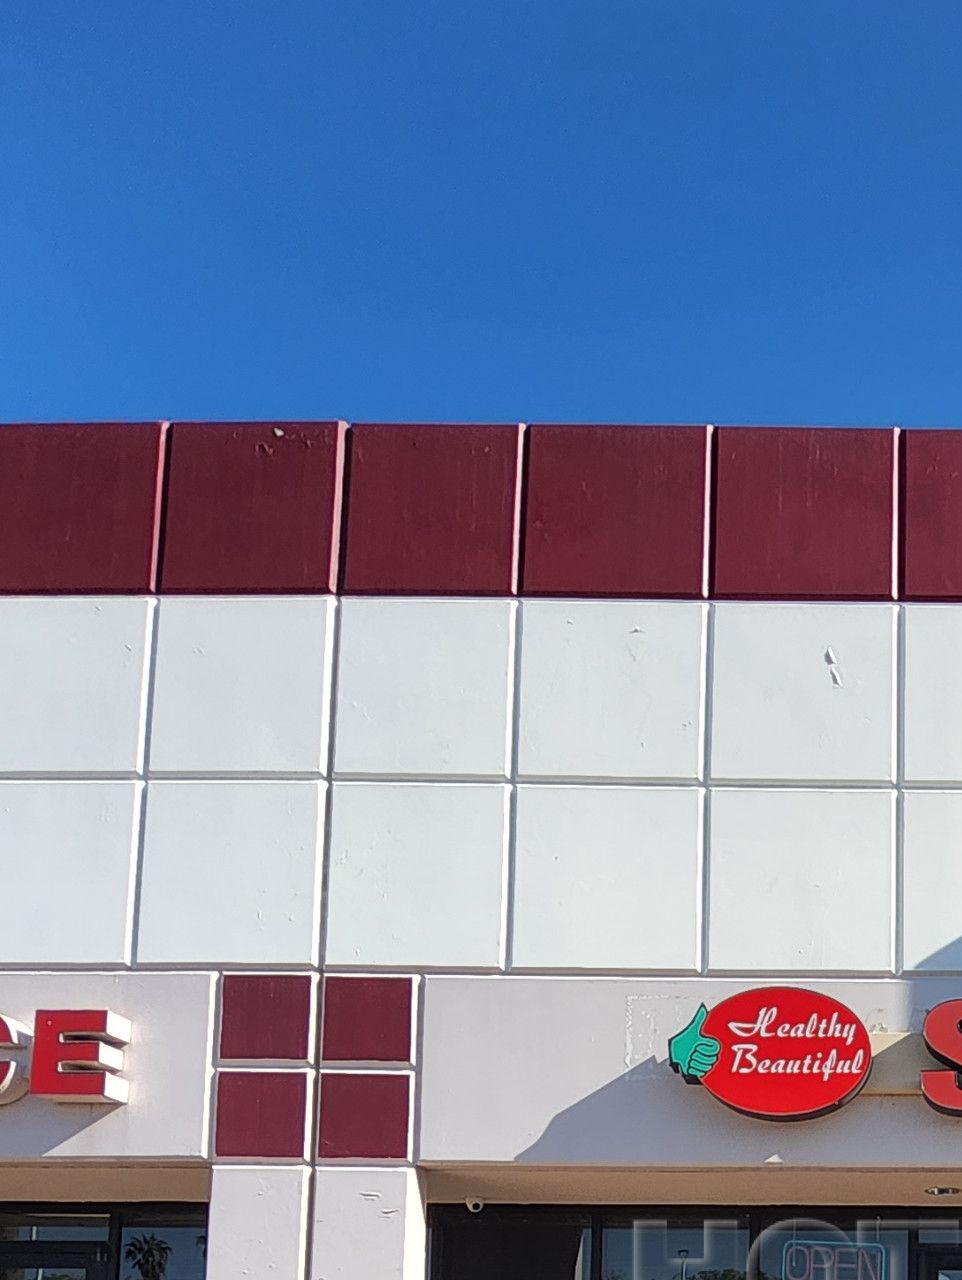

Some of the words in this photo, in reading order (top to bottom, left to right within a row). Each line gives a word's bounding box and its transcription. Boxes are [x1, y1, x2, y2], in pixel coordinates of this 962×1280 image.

[727, 1006, 856, 1046] Healthy
[0, 1010, 128, 1104] E
[731, 1043, 864, 1082] Beautiful
